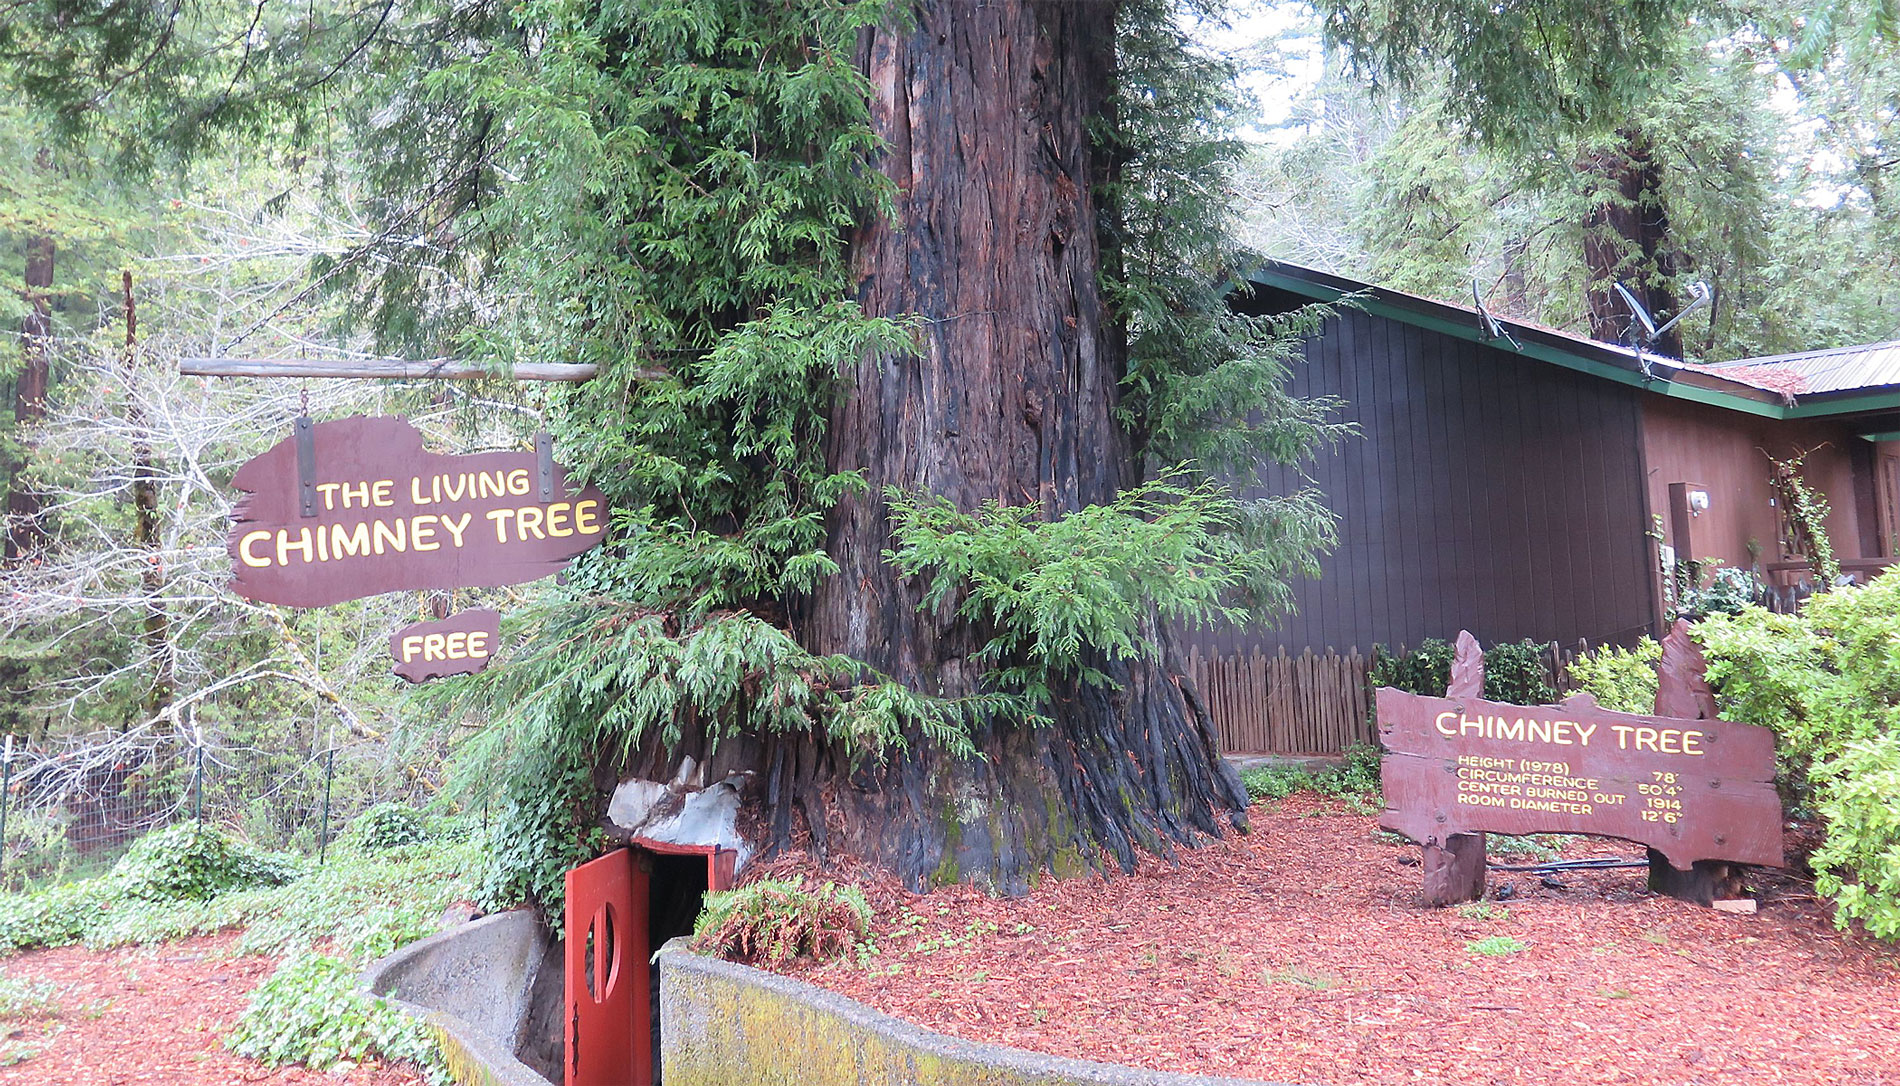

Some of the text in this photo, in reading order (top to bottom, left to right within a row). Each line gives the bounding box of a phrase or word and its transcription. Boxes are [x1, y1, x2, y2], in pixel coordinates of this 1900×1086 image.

[316, 469, 530, 511] THE LIVING
[239, 500, 601, 568] CHIMNEY TREE
[402, 631, 489, 664] FREE
[1435, 712, 1705, 755] CHIMNEY TREE
[1457, 767, 1599, 790] CIRCUMFERENCE
[1458, 755, 1515, 770] HEIGHT
[1520, 759, 1570, 776] (1978)
[1457, 780, 1682, 811] CENTER BURNED OUT 1914
[1457, 793, 1505, 808] ROOM
[1510, 798, 1593, 815] DIAMETER
